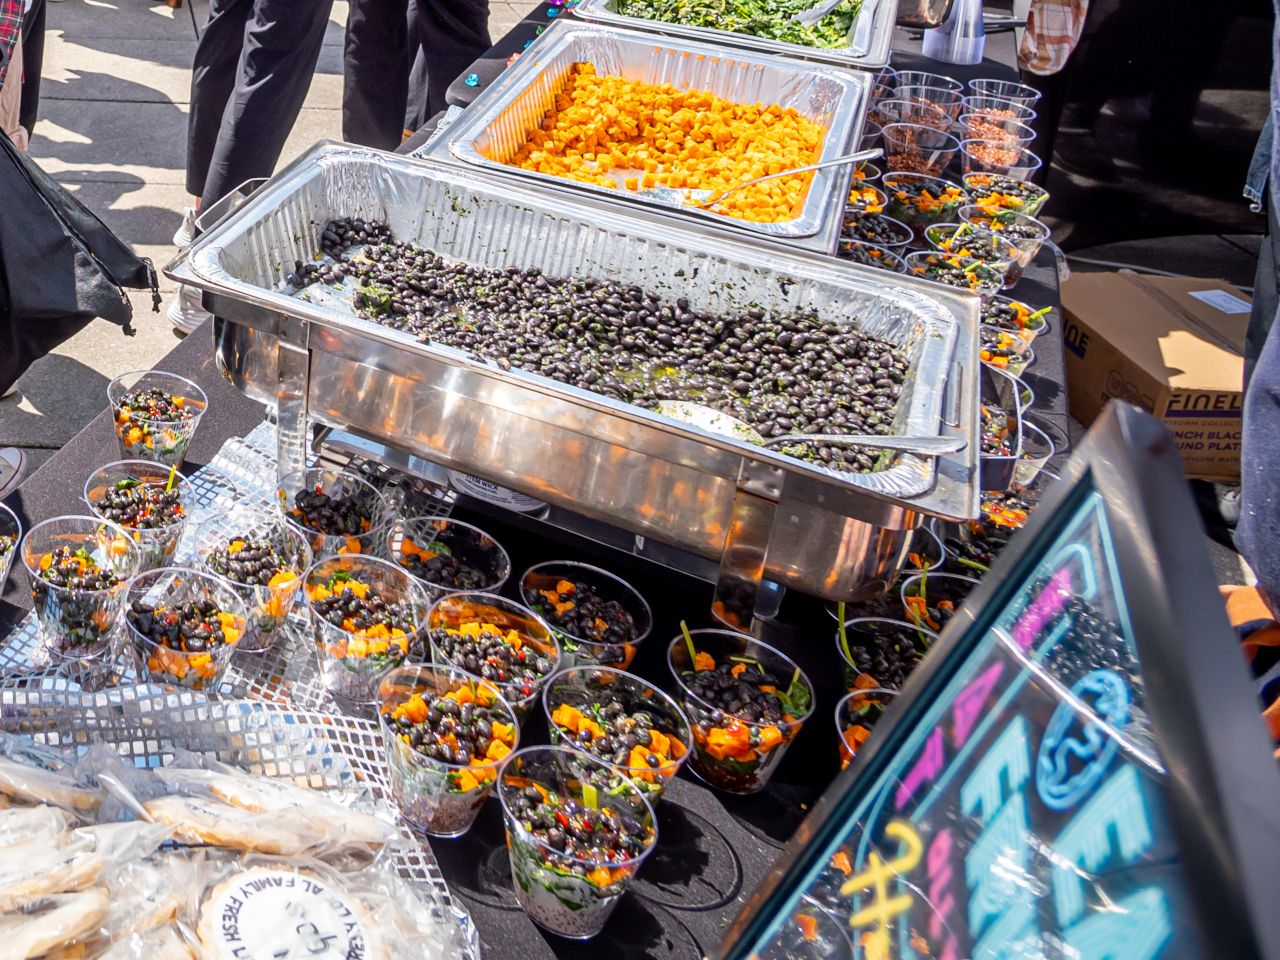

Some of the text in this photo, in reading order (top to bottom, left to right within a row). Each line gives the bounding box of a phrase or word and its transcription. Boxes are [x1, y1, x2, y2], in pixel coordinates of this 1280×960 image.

[1167, 394, 1240, 409] FINEL
[1208, 431, 1241, 440] BLAC
[1176, 442, 1241, 451] UND PLAT
[482, 480, 498, 491] WICK
[239, 876, 295, 899] FAMILY
[302, 879, 352, 918] LOAL
[222, 895, 244, 942] FRESH
